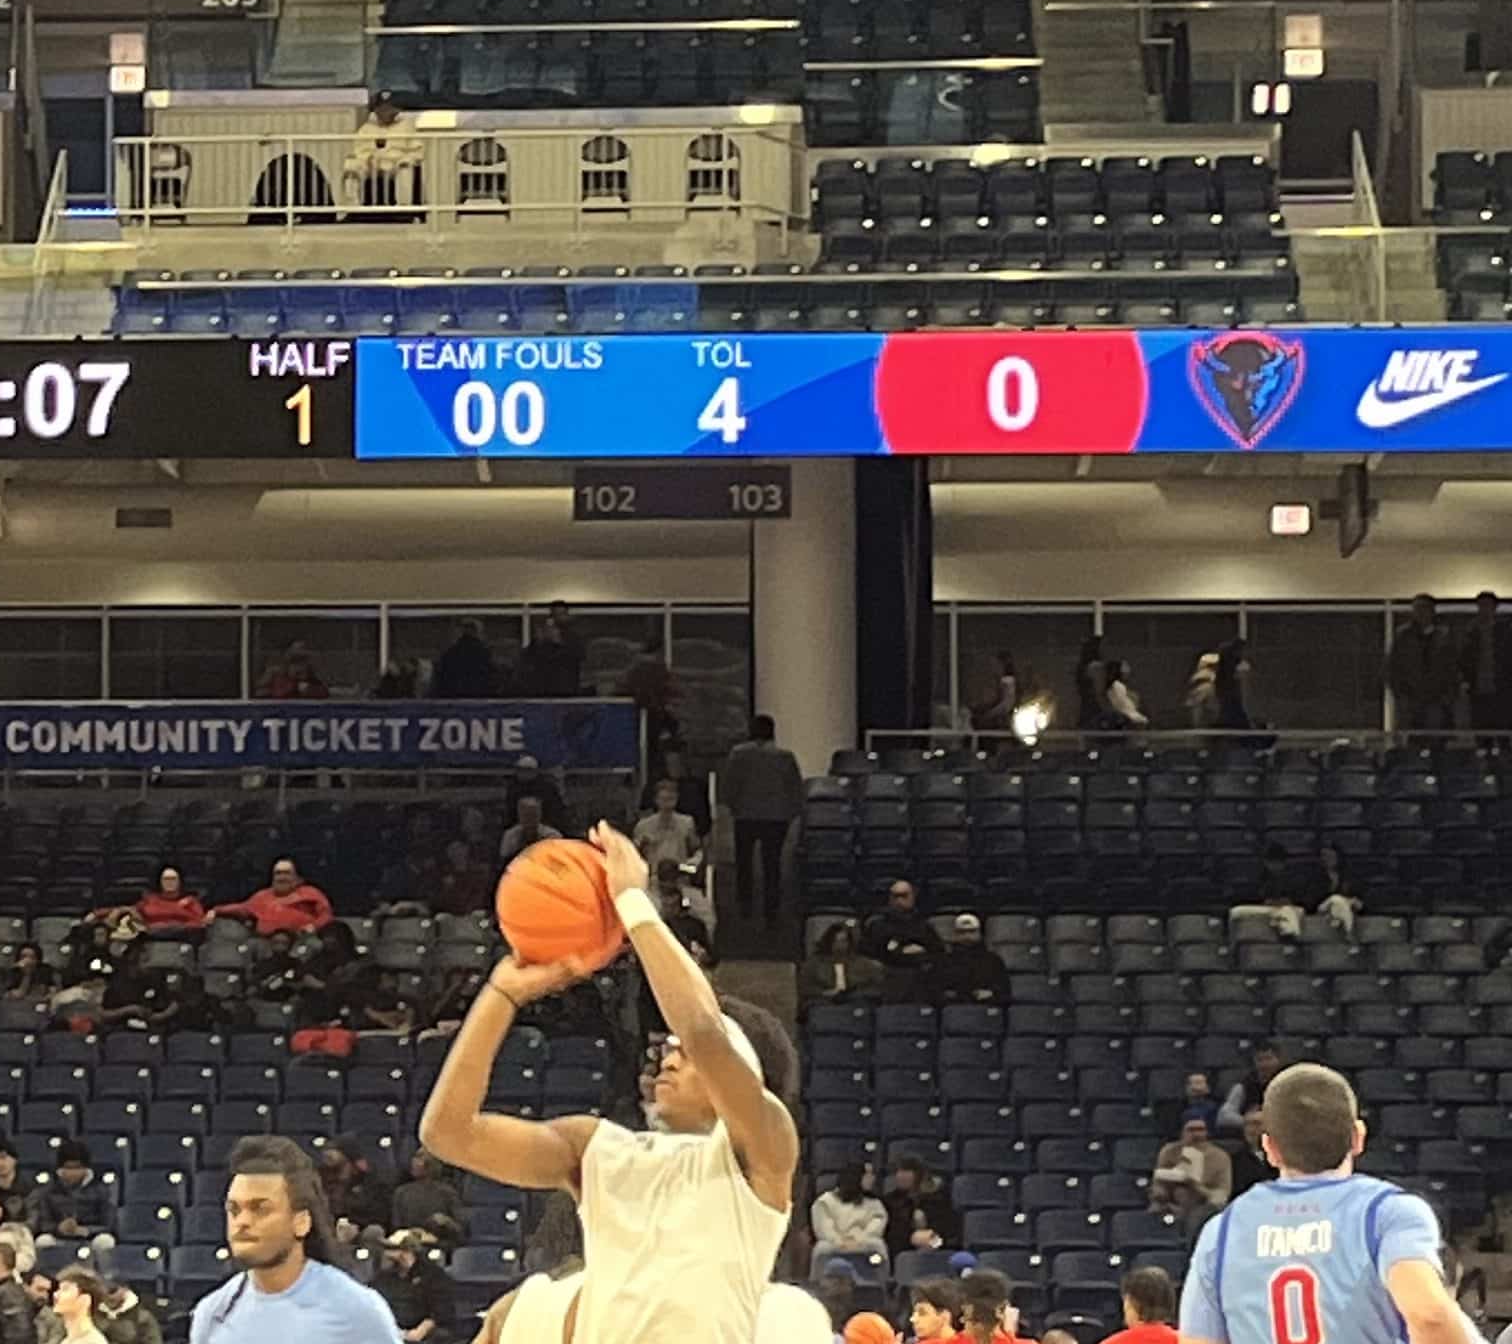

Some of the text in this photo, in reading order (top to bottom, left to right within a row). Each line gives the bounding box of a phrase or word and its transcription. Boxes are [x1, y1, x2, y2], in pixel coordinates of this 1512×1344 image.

[249, 342, 352, 377] HALF
[398, 341, 604, 370] TEAM FOULS
[691, 341, 752, 368] TOL
[1378, 349, 1479, 393] NIKE
[697, 376, 747, 444] 4
[986, 356, 1040, 432] 0
[285, 383, 314, 446] 1
[452, 380, 545, 447] 00
[581, 486, 637, 514] 102
[729, 485, 784, 513] 103
[5, 719, 253, 754] COMMUNITY
[262, 718, 410, 752] TICKET
[419, 717, 525, 752] ZONE
